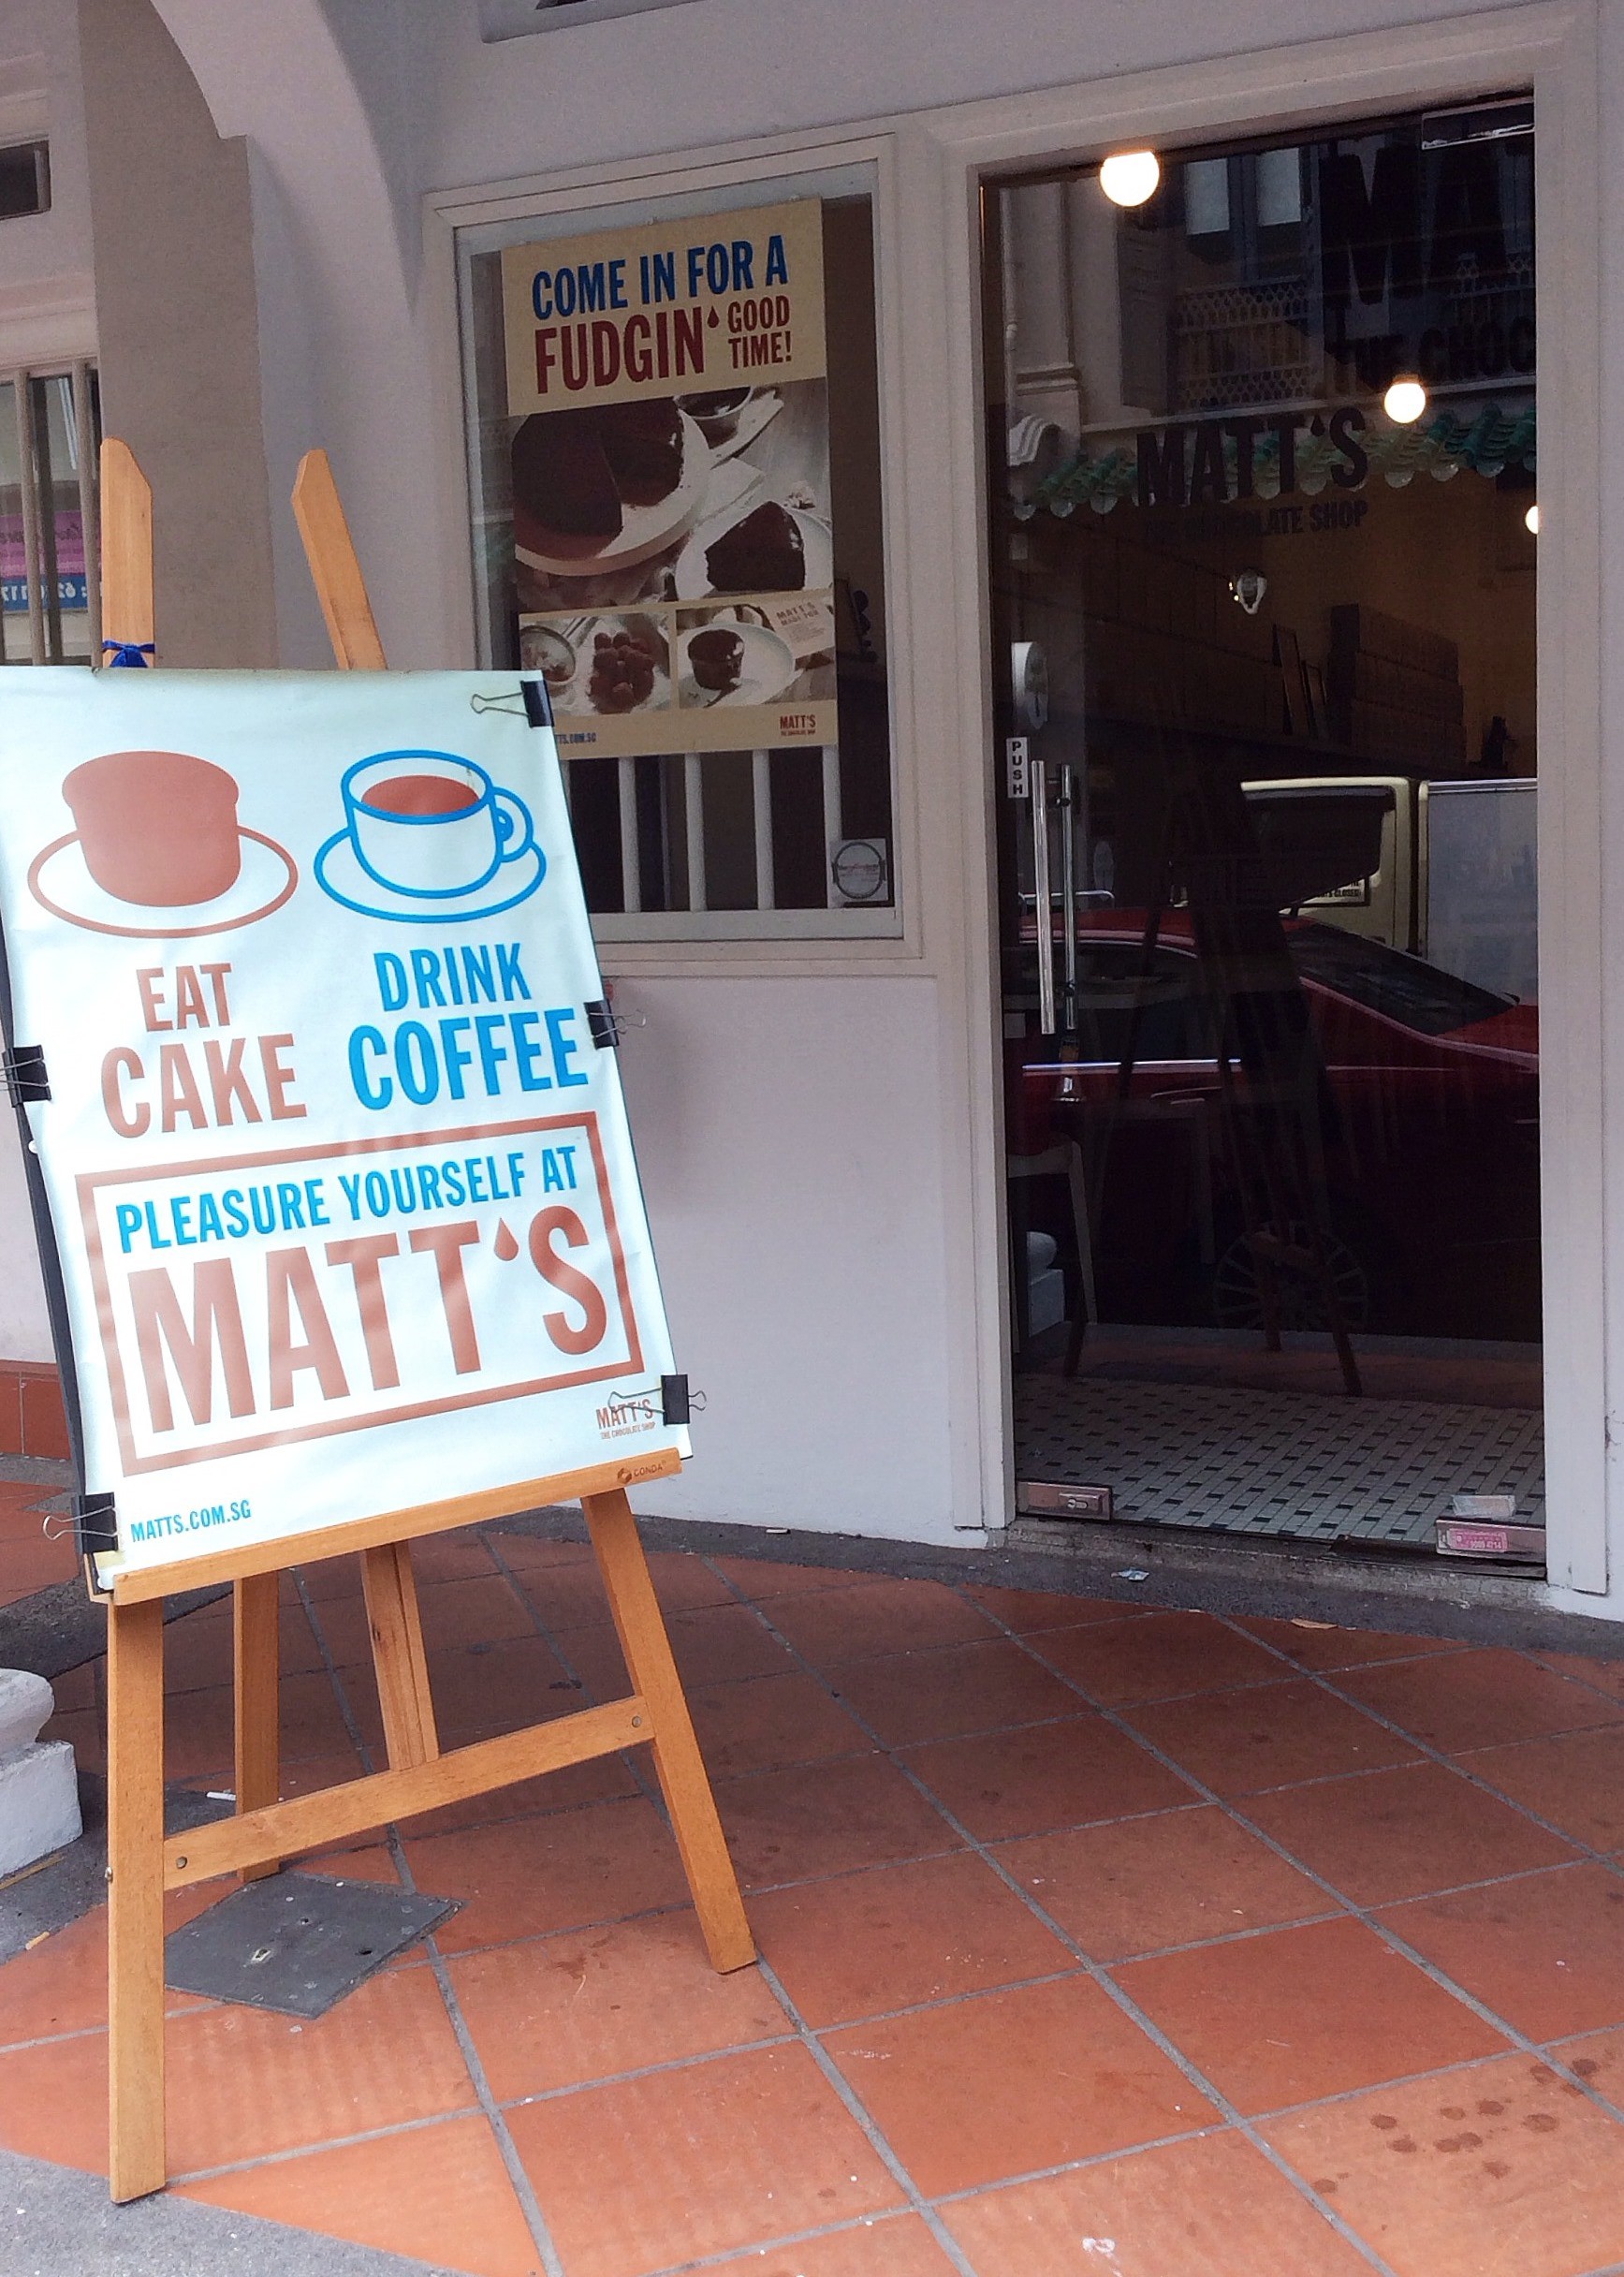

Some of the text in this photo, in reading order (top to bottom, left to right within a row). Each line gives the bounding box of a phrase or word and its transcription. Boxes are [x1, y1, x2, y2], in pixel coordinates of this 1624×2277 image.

[533, 235, 788, 320] COME IN FOR A
[727, 295, 790, 333] GOOD
[535, 305, 720, 394] FUDGIN'
[728, 331, 791, 369] TIME!
[1136, 406, 1368, 507] MATT'S
[1310, 500, 1368, 532] SHOP
[780, 713, 816, 729] MATT'S
[1012, 741, 1023, 795] PUSH
[136, 962, 233, 1033] EAT
[373, 943, 532, 1012] DRINK
[100, 1033, 307, 1138] CAKE
[348, 1008, 589, 1110] COFFEE
[116, 1145, 578, 1254] PLEASURE YOURSELF AT
[127, 1205, 607, 1433] MATT'S
[596, 1399, 653, 1429] MATT'S
[130, 1500, 252, 1543] MATTS.COM.SG
